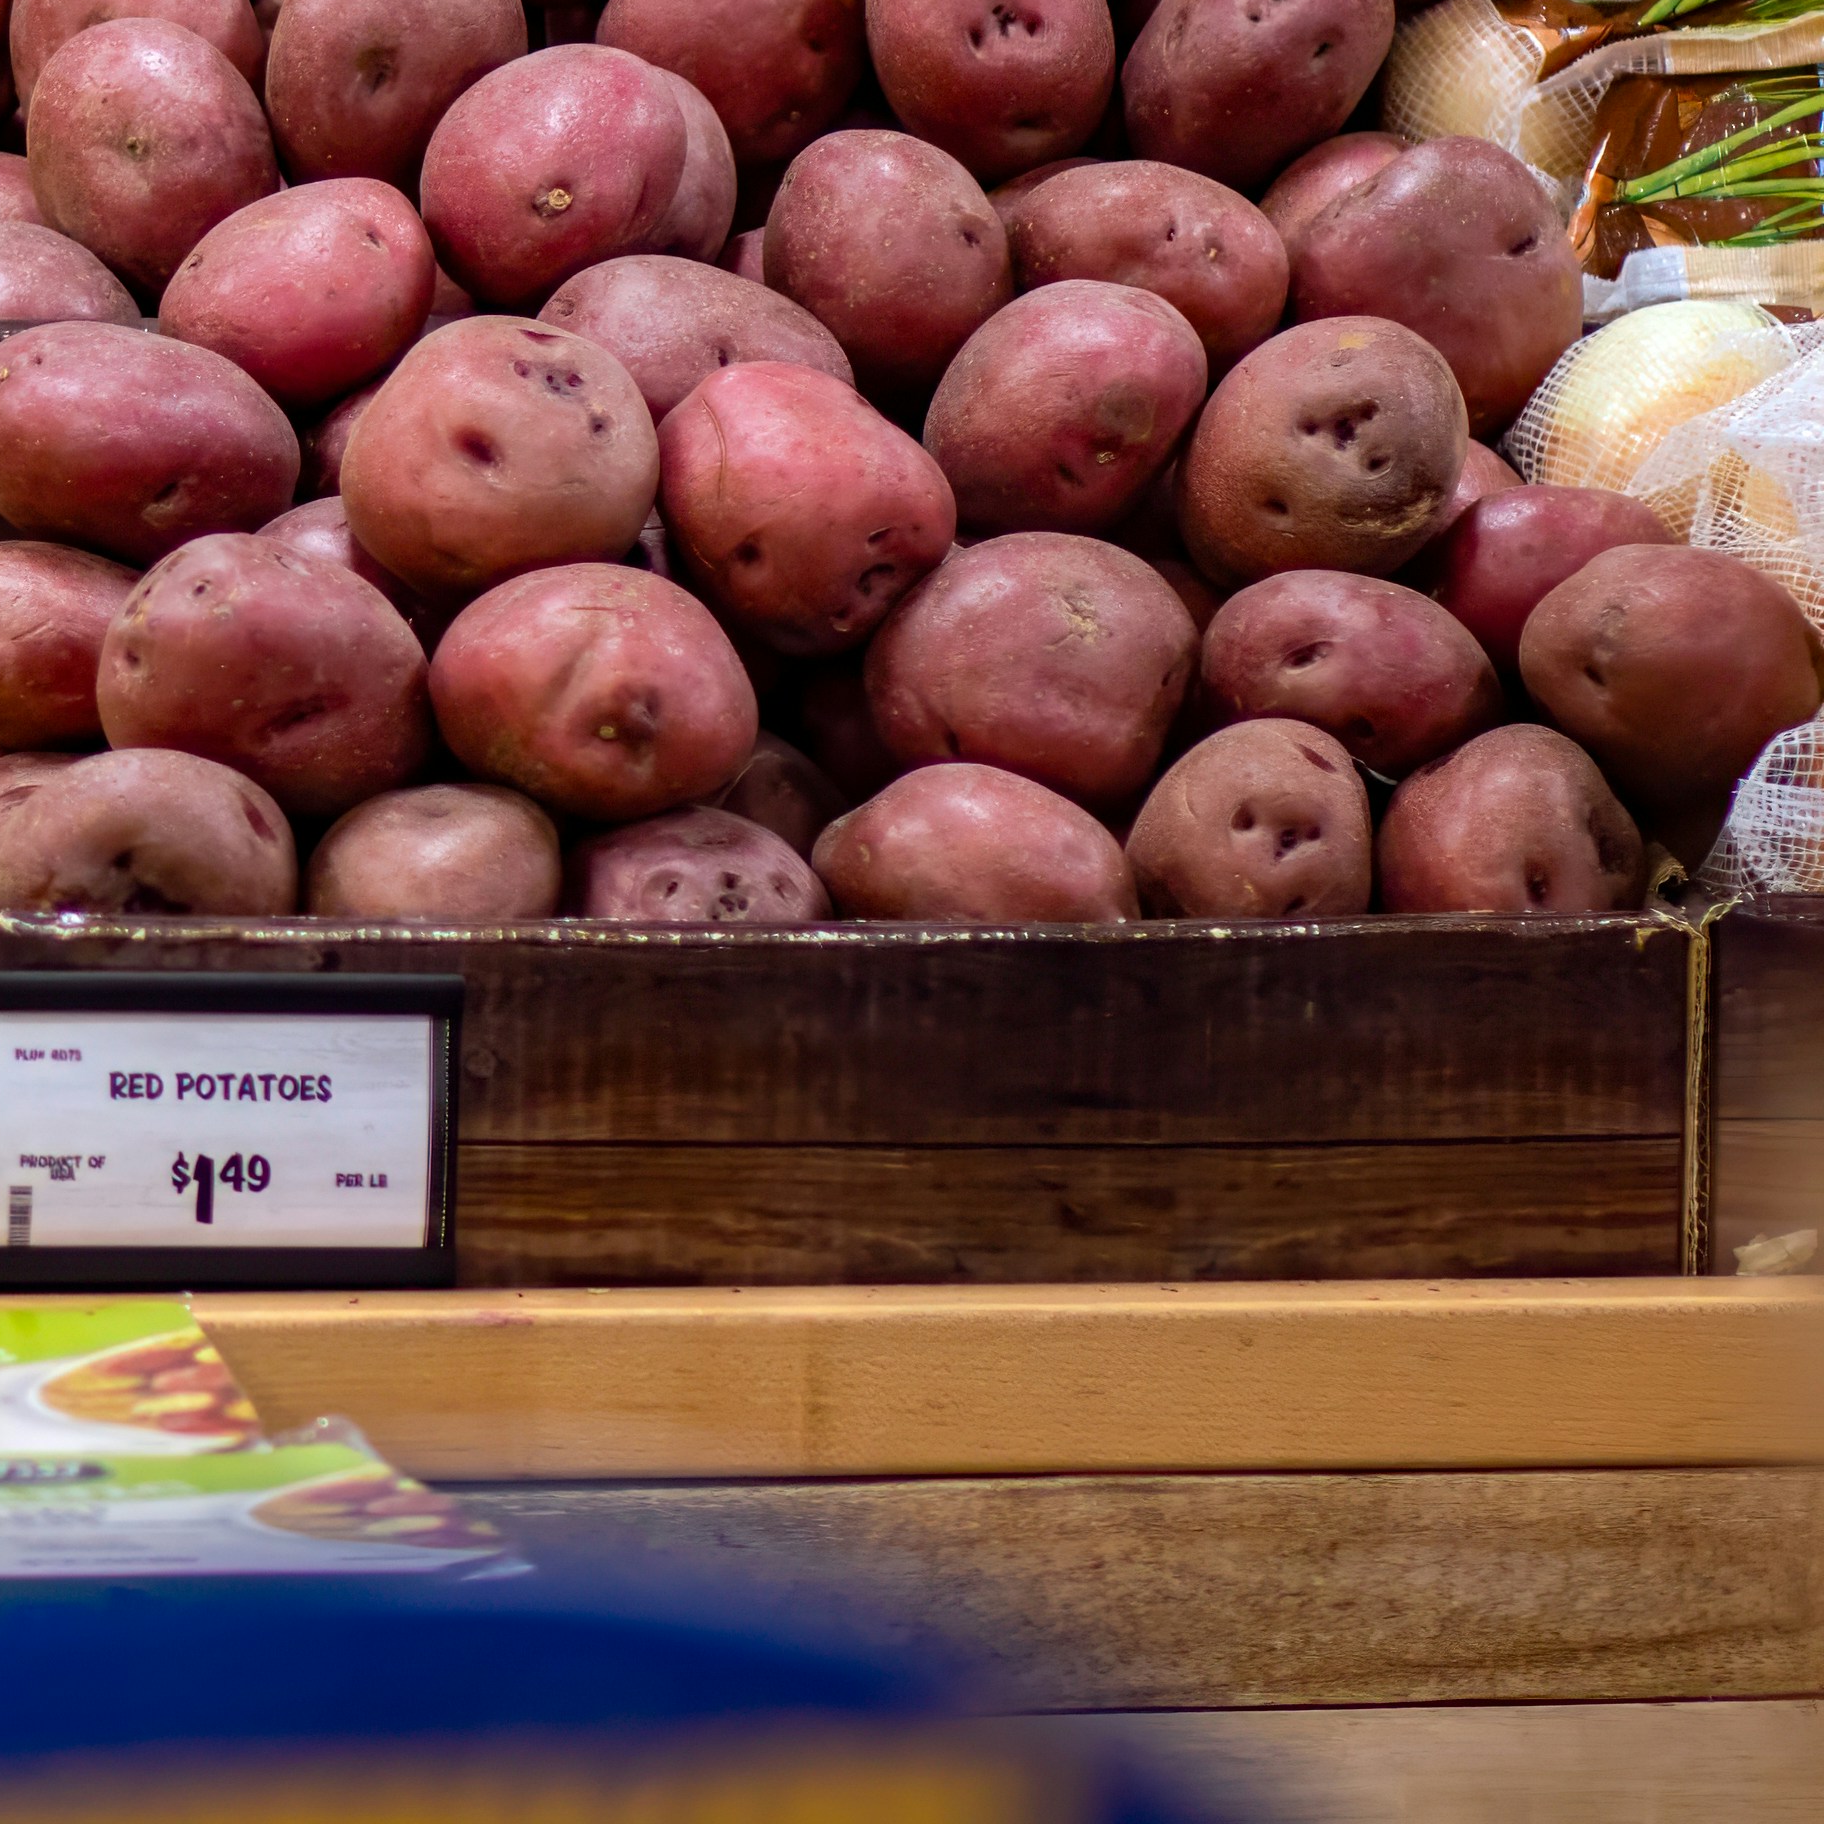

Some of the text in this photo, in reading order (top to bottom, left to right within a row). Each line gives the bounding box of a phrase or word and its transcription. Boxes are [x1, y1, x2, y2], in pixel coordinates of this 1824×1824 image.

[109, 1072, 332, 1103] RED POTATOES
[88, 1155, 105, 1168] OF
[336, 1173, 363, 1188] PER
